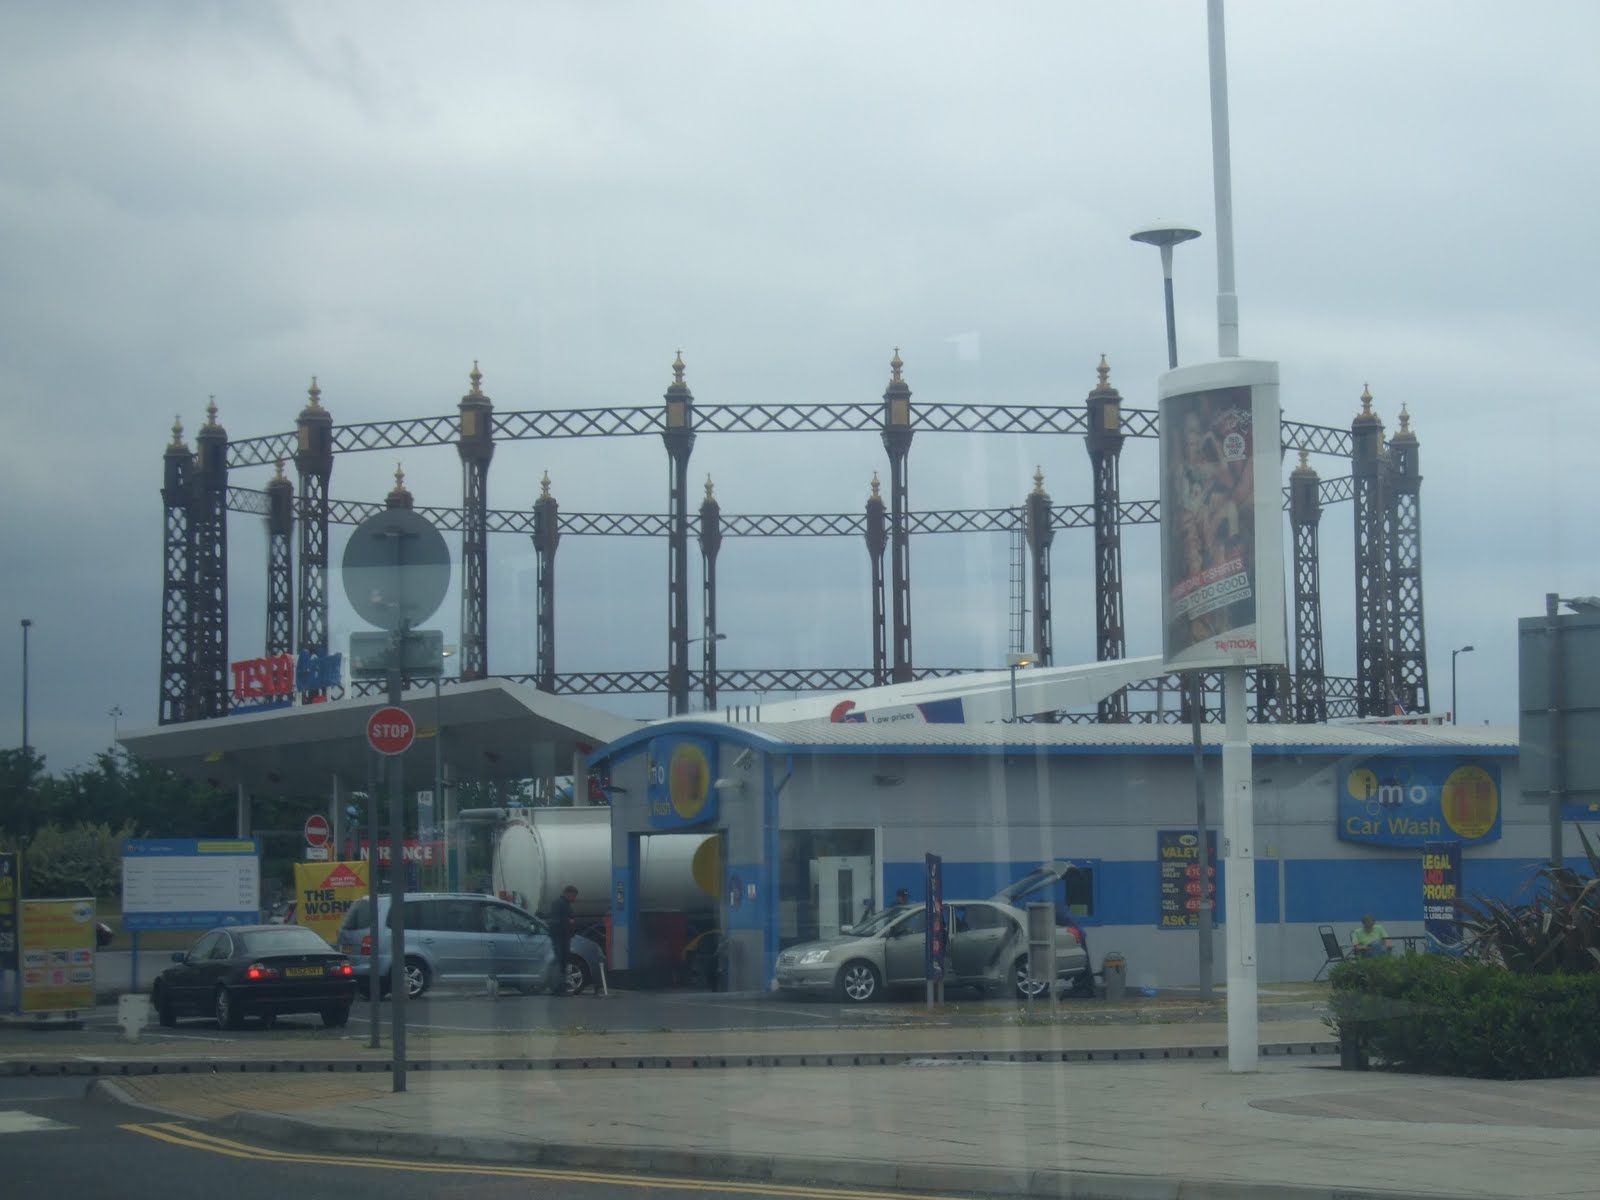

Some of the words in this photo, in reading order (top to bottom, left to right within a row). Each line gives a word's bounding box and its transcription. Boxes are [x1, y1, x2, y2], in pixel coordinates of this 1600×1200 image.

[1201, 587, 1215, 600] DO
[1216, 575, 1247, 593] GOOD
[231, 653, 294, 700] TESCO
[891, 713, 915, 723] prices
[372, 723, 409, 738] STOP
[1365, 776, 1427, 804] imo
[1346, 816, 1381, 834] Car
[1388, 816, 1441, 835] Wash
[1423, 854, 1452, 870] LEGAL
[304, 889, 336, 902] THE
[1162, 915, 1187, 926] ASK
